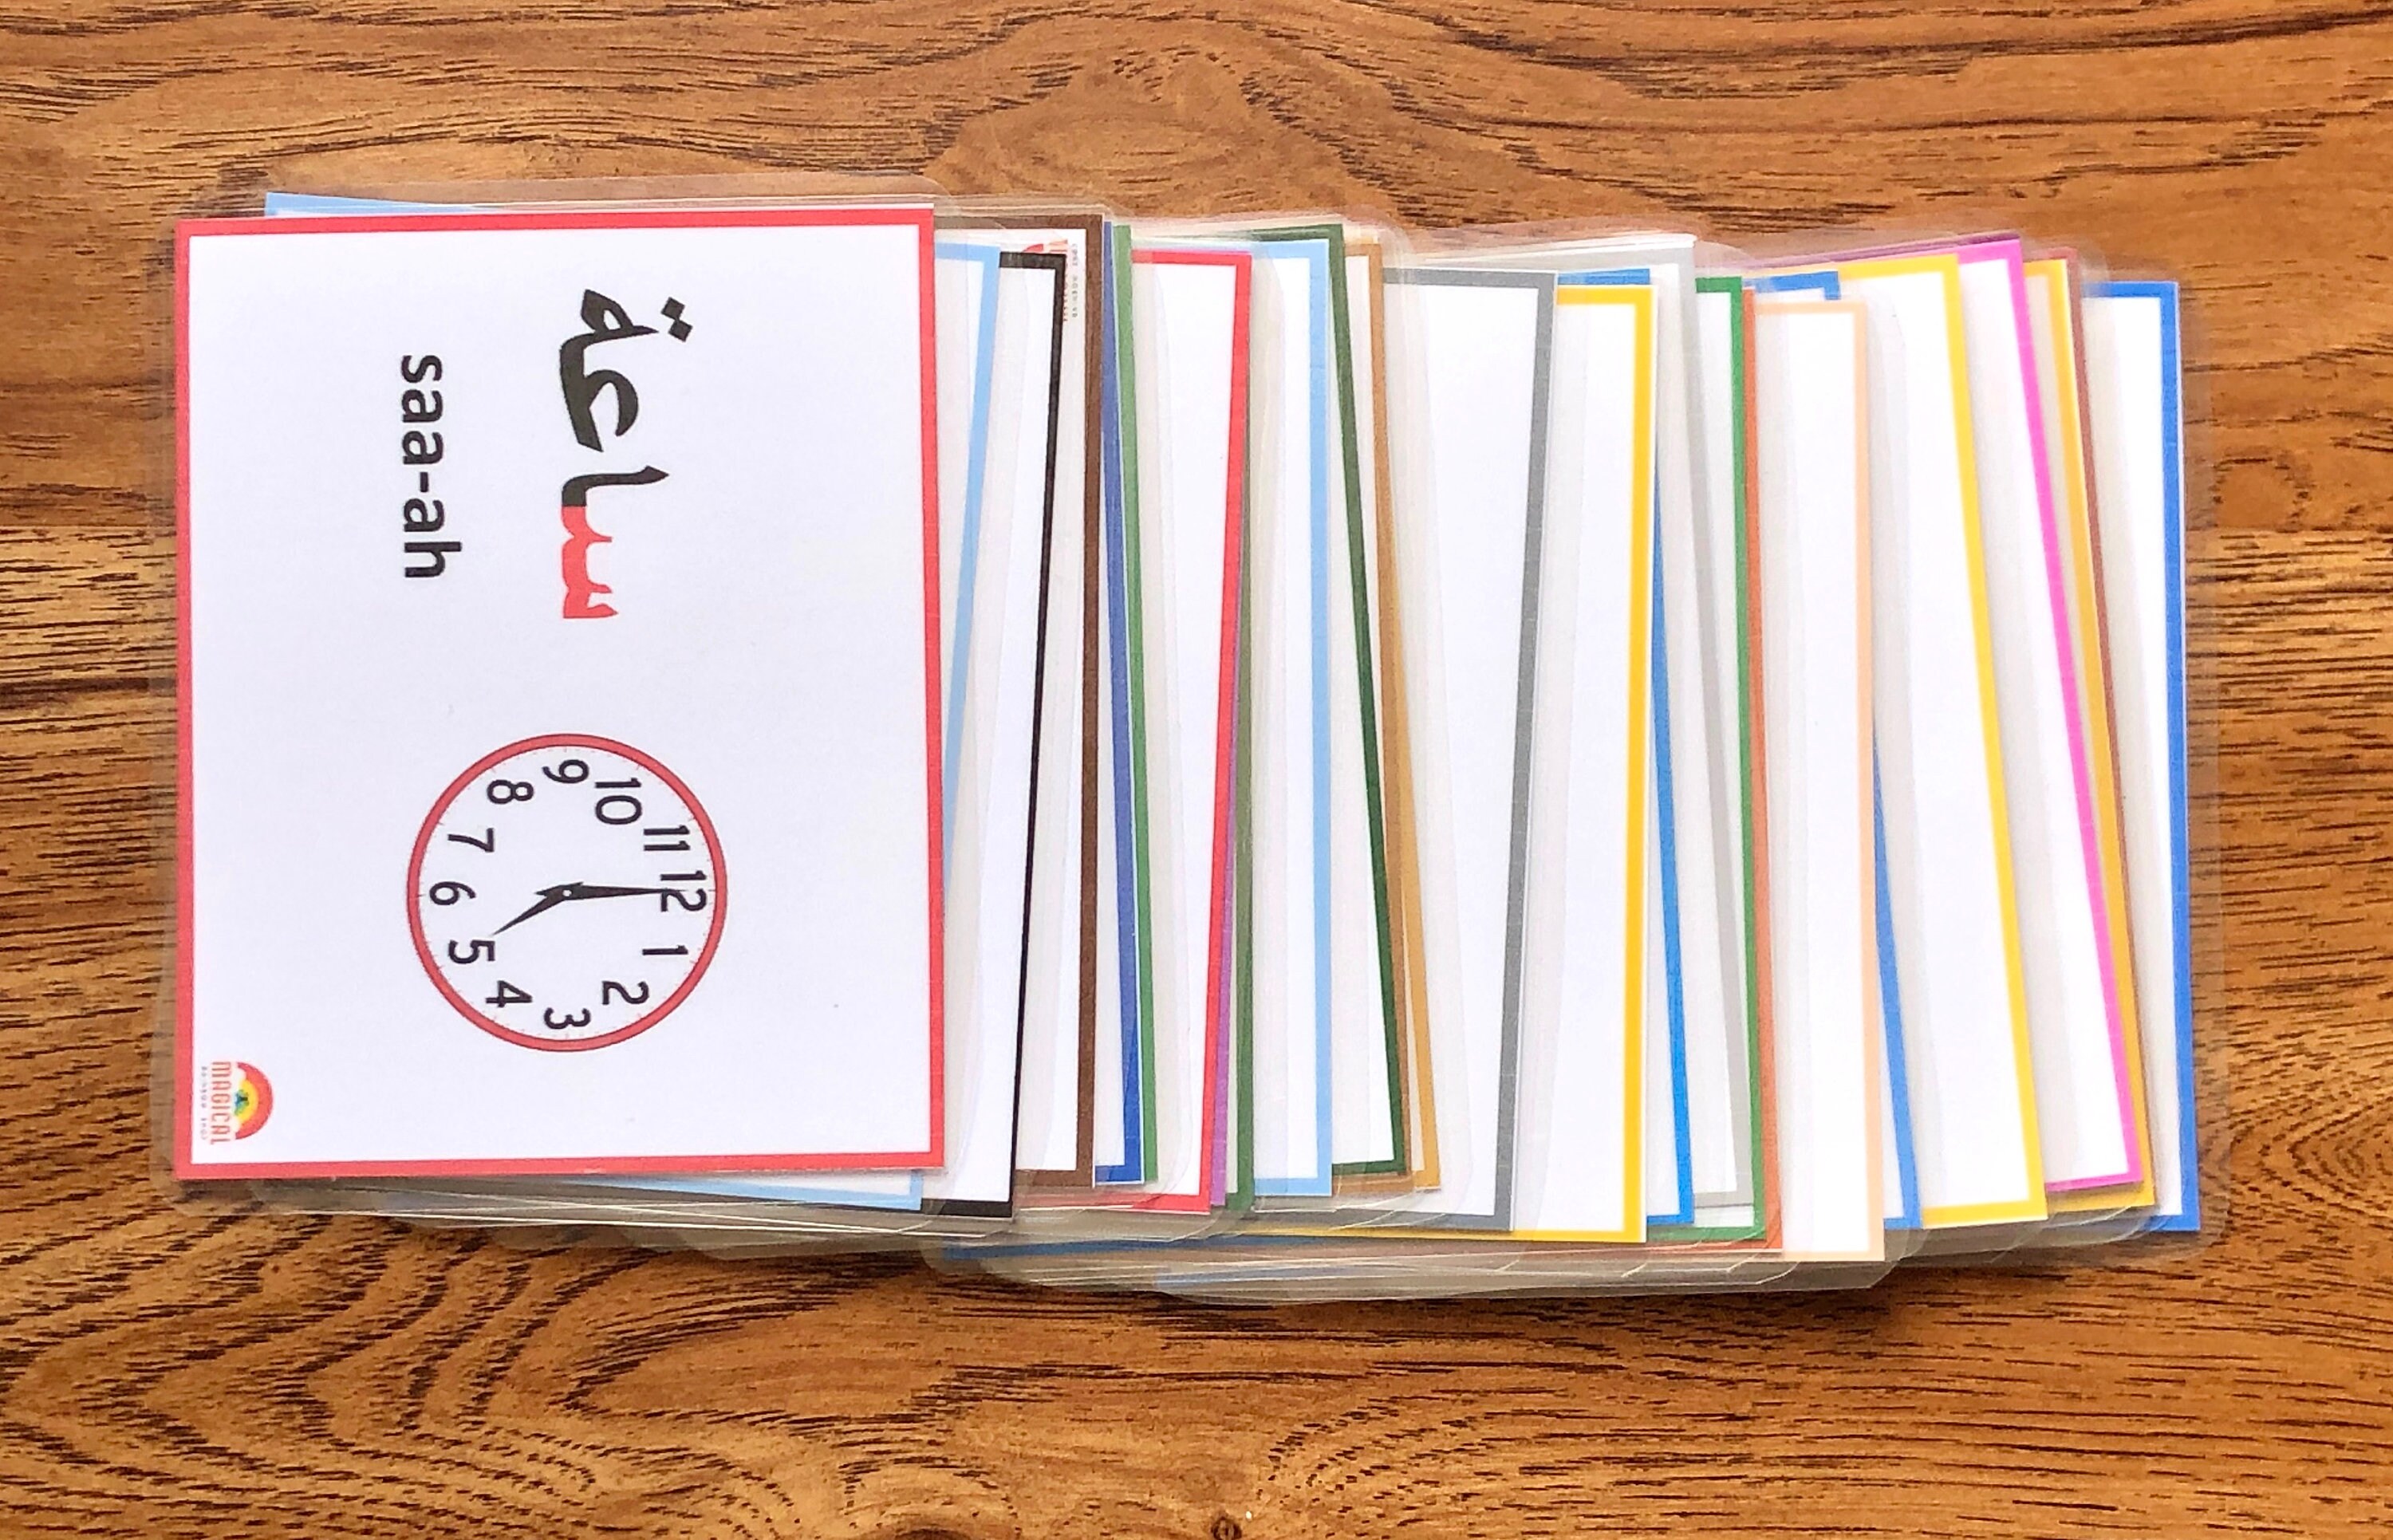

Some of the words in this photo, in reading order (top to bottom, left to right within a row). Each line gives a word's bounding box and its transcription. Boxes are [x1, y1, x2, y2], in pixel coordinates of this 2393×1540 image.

[401, 355, 462, 577] saa-ah
[559, 289, 693, 620] ساعة
[542, 759, 589, 784] 9
[487, 779, 534, 805] 8
[595, 778, 642, 825] 10
[447, 828, 495, 853] 7
[643, 825, 691, 852] 11
[429, 881, 475, 905] 6
[660, 870, 708, 912] 12
[448, 939, 495, 964] 5
[642, 945, 688, 955] 1
[486, 981, 532, 1007] 4
[602, 981, 649, 1005] 2
[544, 1007, 590, 1030] 3
[211, 1061, 231, 1144] MAGICAL
